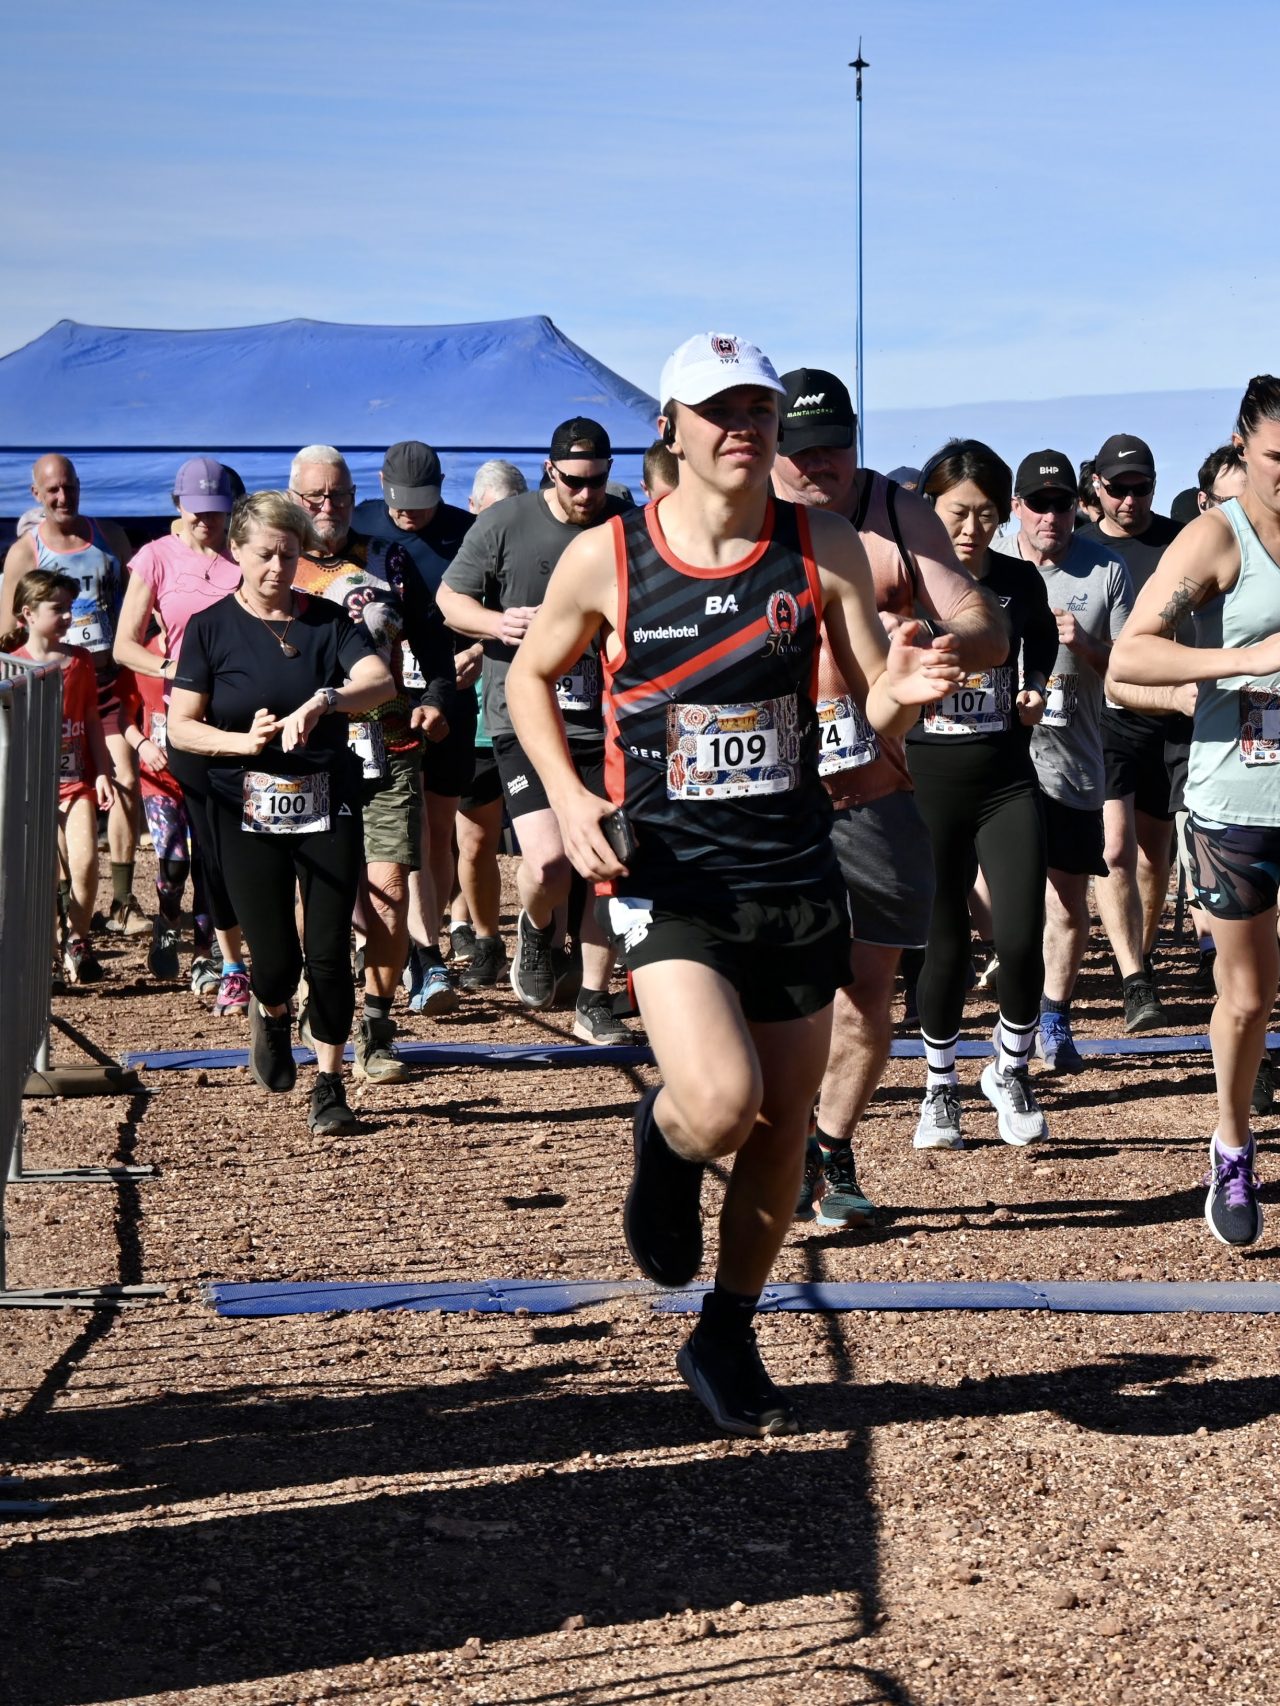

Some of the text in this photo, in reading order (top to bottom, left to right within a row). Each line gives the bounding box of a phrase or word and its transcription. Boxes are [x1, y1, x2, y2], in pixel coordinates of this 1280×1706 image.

[1039, 466, 1059, 475] BHP
[705, 594, 739, 616] BA
[82, 627, 91, 640] 6
[633, 624, 699, 643] glyndehotel
[951, 691, 987, 713] 107
[630, 746, 669, 760] GER
[709, 734, 767, 768] 109
[269, 795, 306, 815] 100
